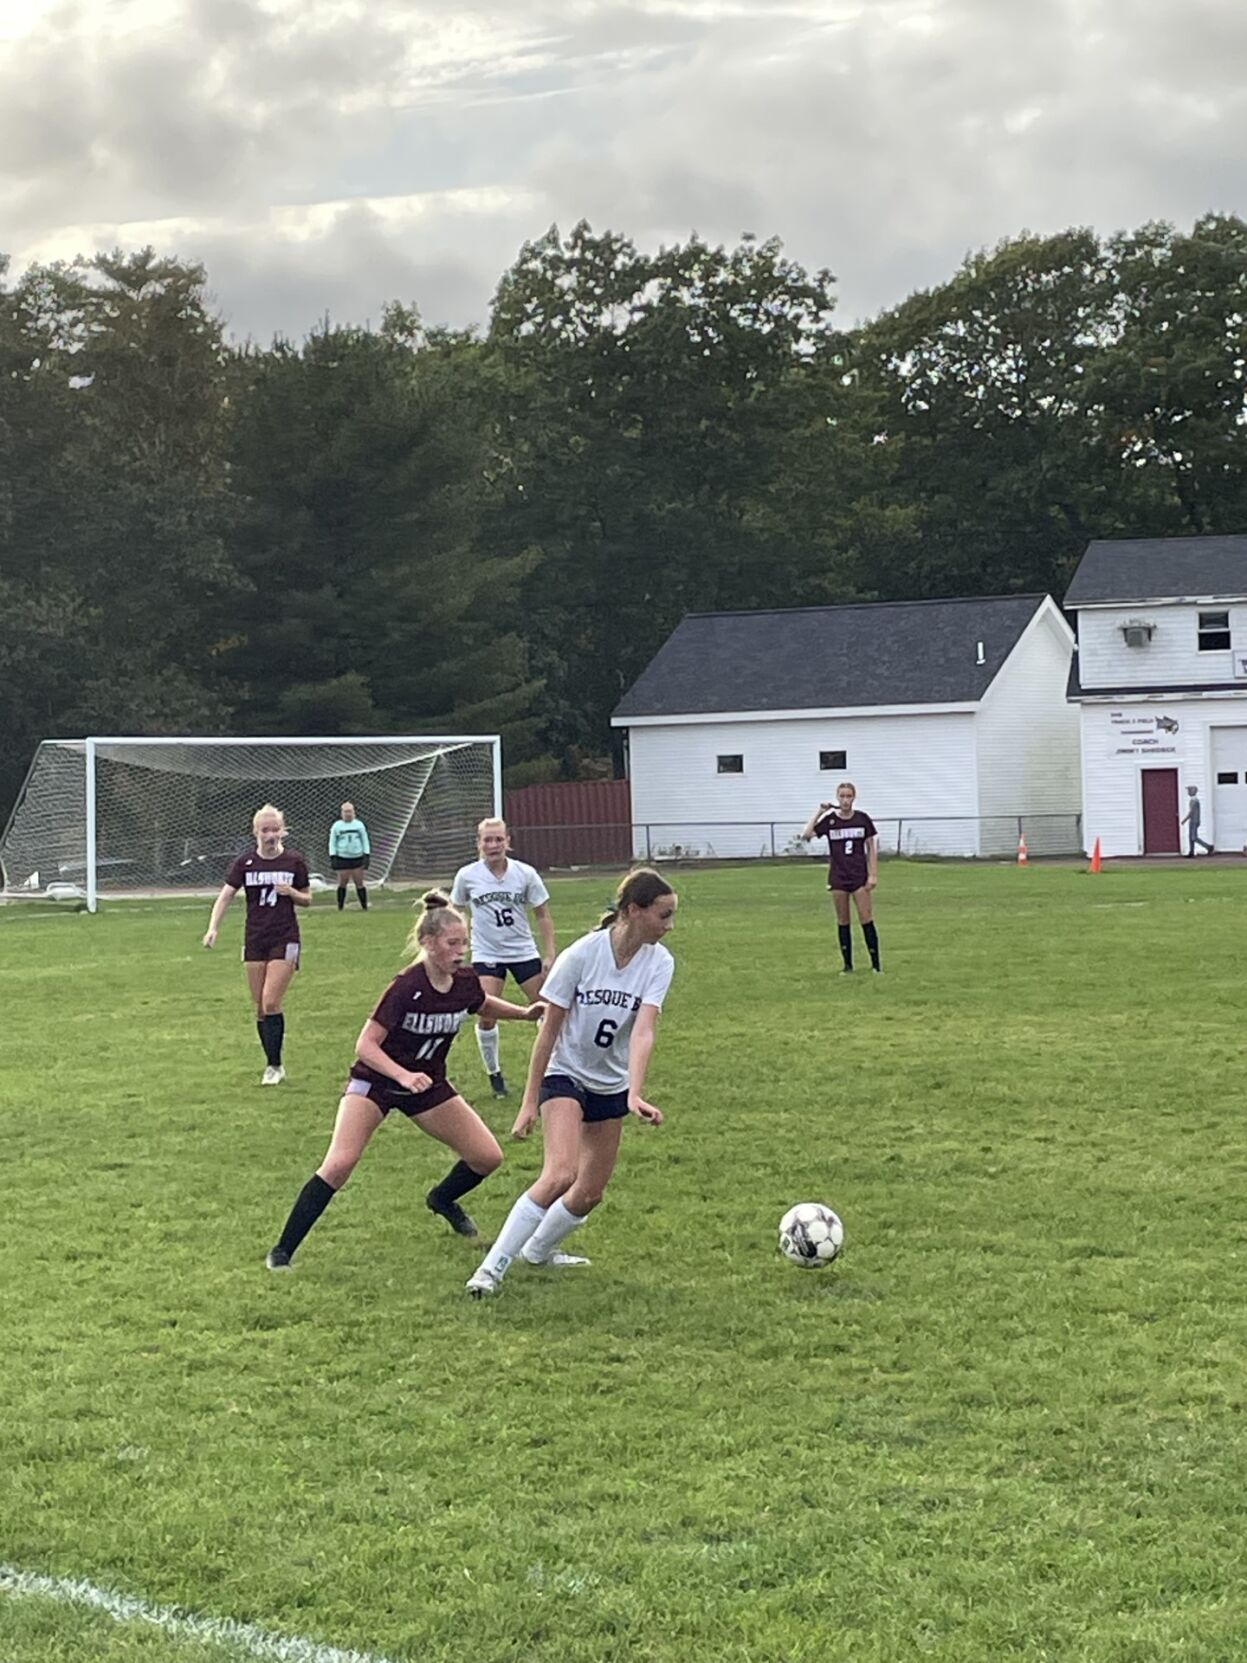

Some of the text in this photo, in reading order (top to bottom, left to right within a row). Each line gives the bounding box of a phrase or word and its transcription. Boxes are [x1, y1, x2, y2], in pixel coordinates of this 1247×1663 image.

[844, 840, 853, 855] 2
[259, 887, 277, 907] 14
[494, 908, 514, 927] 16
[594, 1018, 618, 1048] 6
